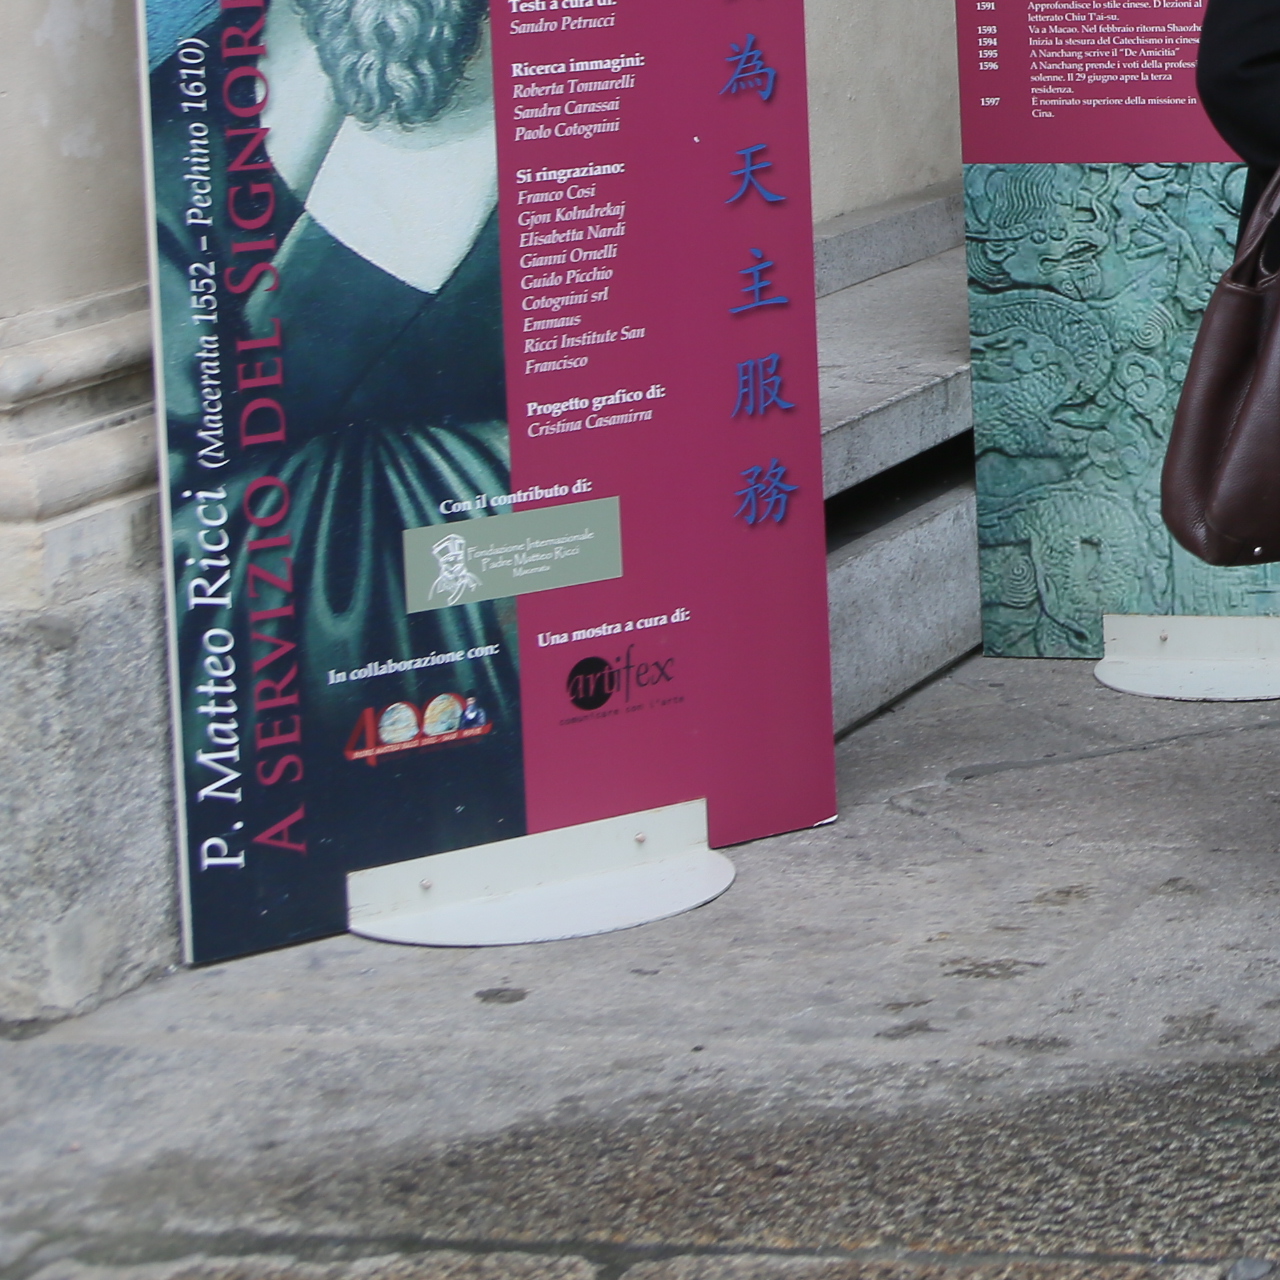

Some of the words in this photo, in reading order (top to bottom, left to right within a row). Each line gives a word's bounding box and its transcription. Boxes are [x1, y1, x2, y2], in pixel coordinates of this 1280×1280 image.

[549, 0, 559, 10] a
[976, 1, 994, 9] 1591
[509, 17, 558, 34] Sandro
[560, 12, 615, 30] Petrucci
[177, 37, 210, 113] 1610)
[510, 61, 567, 77] Ricerca
[569, 52, 645, 72] immagini:
[511, 82, 565, 98] Roberta
[566, 73, 635, 93] Tonnarelli
[513, 102, 562, 120] Sandra
[563, 96, 620, 115] Carassai
[980, 97, 1000, 105] 1597
[1040, 97, 1080, 105] nominato
[1082, 97, 1122, 106] superiore
[1124, 96, 1145, 104] della
[1148, 96, 1186, 104] missione
[1188, 95, 1196, 103] in
[513, 124, 552, 141] Paolo
[553, 117, 620, 139] Cotognini
[182, 121, 214, 228] Pechino
[515, 168, 533, 184] Si
[534, 162, 625, 183] ringraziano:
[517, 189, 564, 205] Franco
[565, 182, 596, 199] Cosi
[517, 210, 551, 230] Gjon
[554, 200, 625, 221] Kolndrekaj
[518, 228, 584, 247] Elisabetta
[586, 221, 626, 239] Nardi
[519, 249, 567, 268] Gianni
[569, 243, 618, 262] Ornelli
[519, 271, 563, 290] Guido
[564, 265, 613, 284] Picchio
[190, 261, 218, 325] 1552
[521, 289, 589, 311] Cotognini
[590, 285, 609, 302] srl
[522, 314, 581, 332] Emmaus
[523, 334, 558, 353] Ricci
[559, 329, 618, 348] Institute
[619, 324, 645, 340] San
[524, 354, 589, 374] Francisco
[236, 317, 288, 450] DEL
[195, 333, 229, 470] (Macerata
[525, 397, 589, 417] Progetto
[591, 388, 643, 411] grafico
[645, 383, 666, 399] di:
[527, 414, 583, 437] Cristina
[584, 408, 653, 428] Casamirra
[439, 499, 472, 514] Con
[475, 494, 487, 509] il
[490, 482, 569, 507] contributo
[572, 478, 593, 494] di:
[181, 483, 232, 610] Ricci
[467, 543, 525, 561] Fondazione
[526, 529, 594, 551] Internazionale
[481, 556, 512, 572] Padre
[514, 551, 553, 566] Matteo
[554, 545, 580, 559] Ricci
[242, 475, 304, 787] SERVIZIO
[537, 631, 569, 647] Una
[571, 622, 622, 641] mostra
[623, 620, 634, 632] a
[635, 614, 668, 629] cura
[670, 606, 691, 623] di:
[327, 668, 347, 685] In
[348, 649, 465, 680] collaborazione
[465, 642, 500, 663] con:
[566, 644, 675, 703] artifex
[196, 627, 242, 803] Matteo
[252, 804, 307, 855] A
[200, 821, 245, 872] P.
